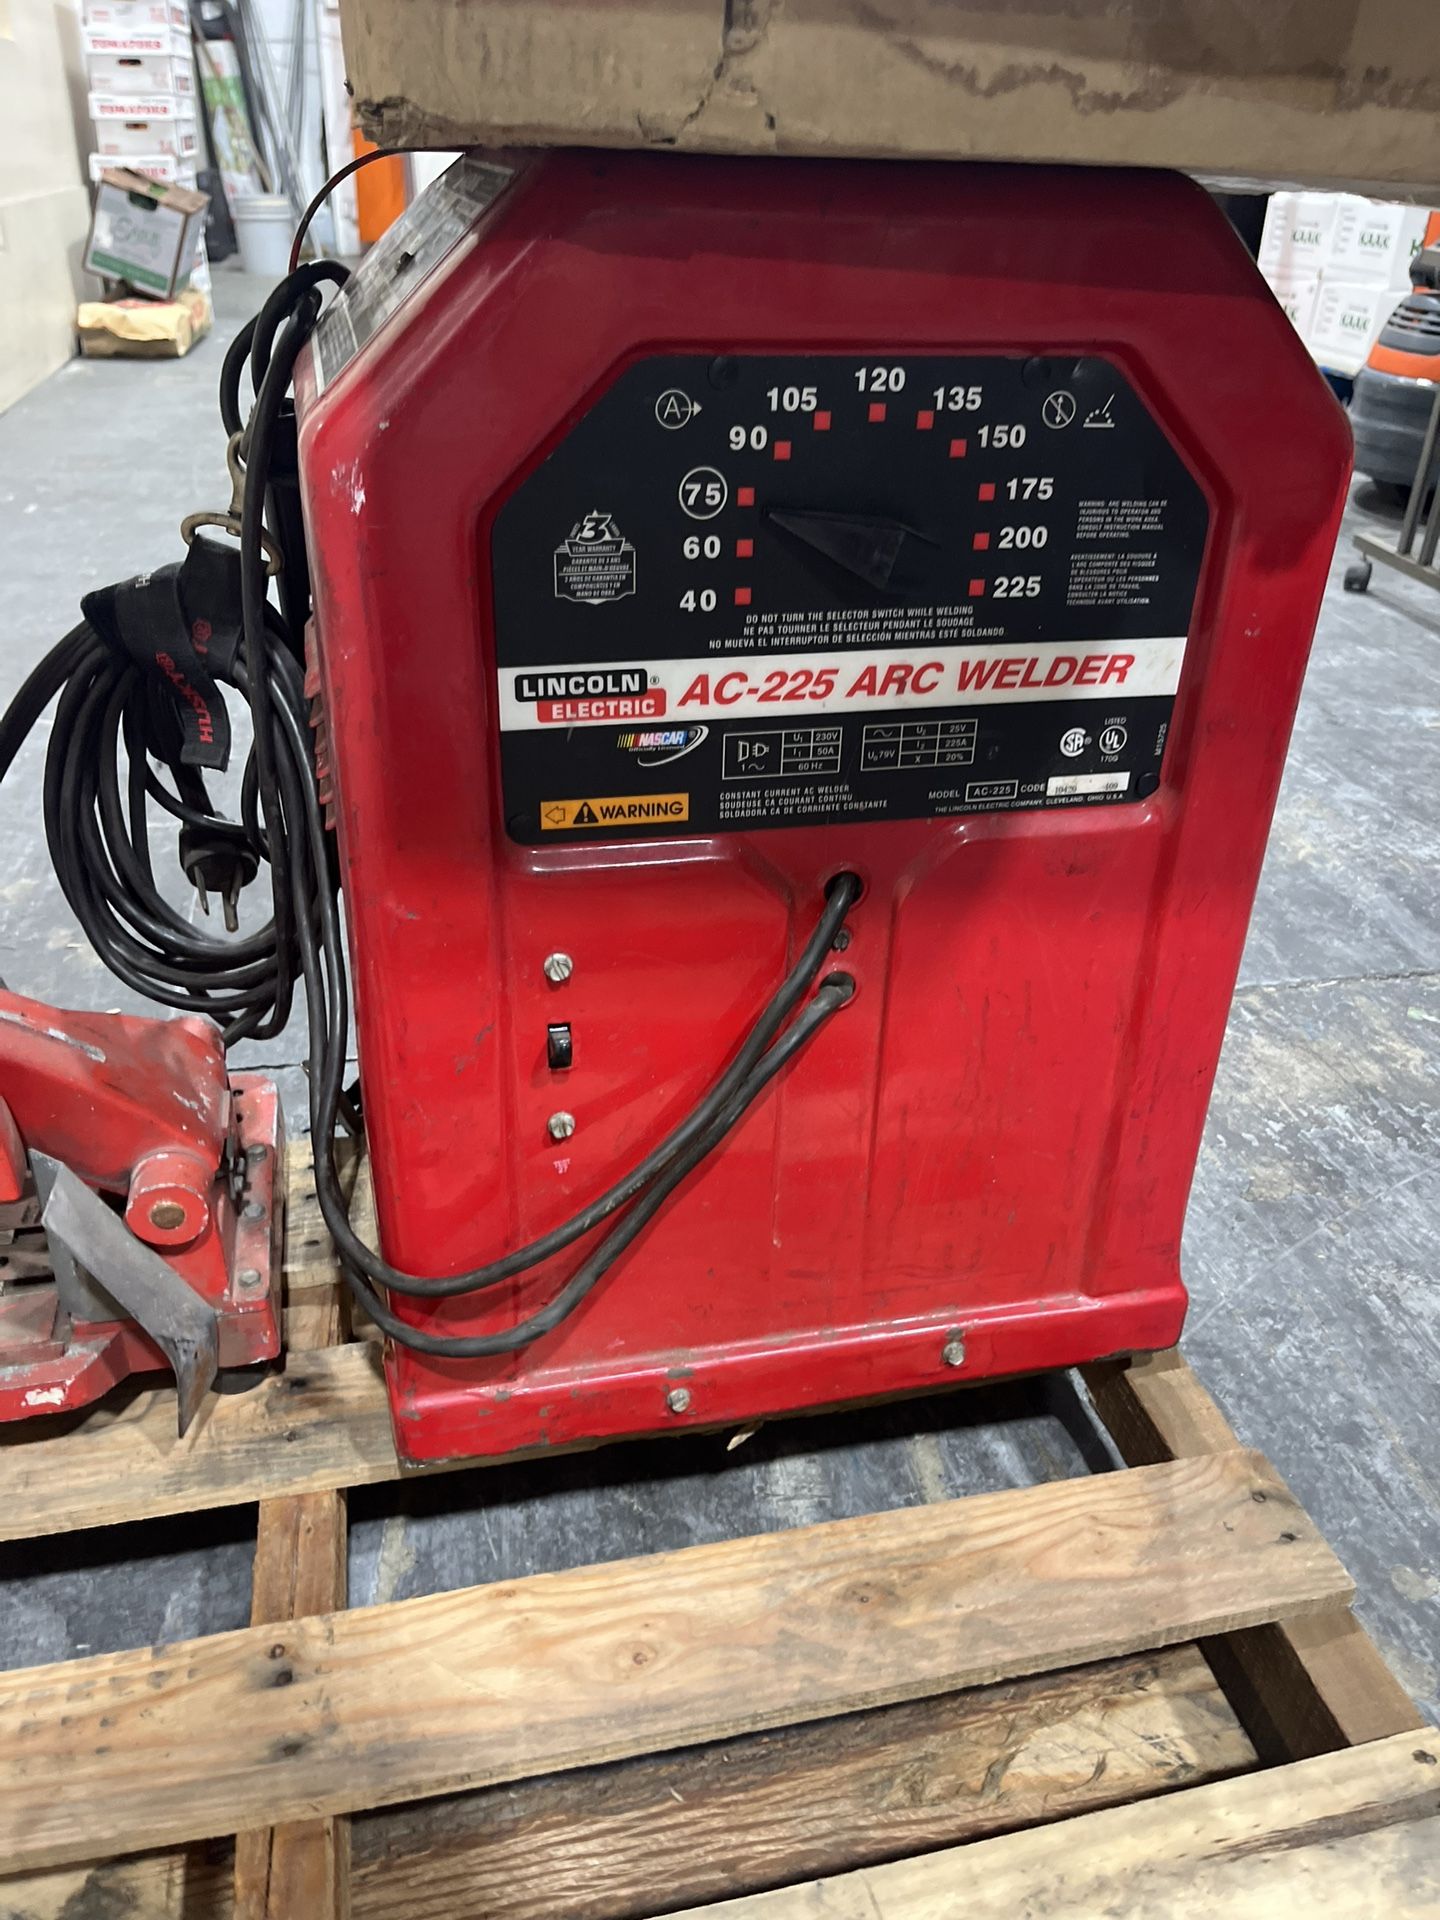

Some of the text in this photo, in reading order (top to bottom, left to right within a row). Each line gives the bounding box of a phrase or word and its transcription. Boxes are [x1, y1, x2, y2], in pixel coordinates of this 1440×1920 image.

[855, 366, 906, 392] 120
[767, 386, 818, 412] 105
[933, 386, 983, 411] 135
[729, 425, 768, 451] 90
[977, 424, 1027, 449] 150
[685, 483, 721, 506] 75
[1006, 477, 1055, 501] 175
[577, 514, 612, 545] 3
[998, 525, 1048, 549] 200
[572, 544, 617, 554] YEAR WARRANTY
[683, 535, 721, 559] 60
[992, 576, 1042, 598] 225
[679, 589, 717, 612] 40
[746, 605, 974, 624] DO NOT TURN THE SELECTOR SWITCH WHILE WELDING
[744, 626, 755, 636] NE
[758, 625, 774, 636] PAS
[778, 623, 817, 635] TOURNER
[820, 623, 830, 633] LE
[883, 618, 921, 630] PENDANT
[923, 618, 934, 628] LE
[936, 616, 975, 627] SOUDAGE
[709, 626, 1005, 650] NO MUEVA EL INTERRUPTOR DE SELECCIÓN MIENTRAS ESTÉ SOLDANDO
[522, 673, 641, 698] LINCOLN
[677, 653, 1137, 707] AC-225 ARC WELDER
[551, 699, 656, 720] ELECTRIC
[949, 724, 967, 734] 25V
[1104, 716, 1127, 726] LISTED
[638, 731, 686, 748] NASCAR
[816, 731, 839, 742] 230V
[945, 738, 968, 748] 225A
[817, 745, 835, 756] 50A
[945, 753, 964, 762] 20%
[798, 762, 824, 771] 60 Hz
[719, 784, 850, 800] CONSTANT CURRENT AC WELDER
[928, 783, 1045, 799] MODEL AC-225 CODE
[600, 801, 684, 820] WARNING
[719, 794, 853, 810] SOUDEUSE CA COURANT CONTINU
[719, 800, 888, 819] SOLDADORA CA DE CORRIENTE CONSTANTE
[948, 803, 977, 812] LINCOLN
[978, 801, 1010, 810] ELECTRIC
[1087, 794, 1105, 802] OHIO
